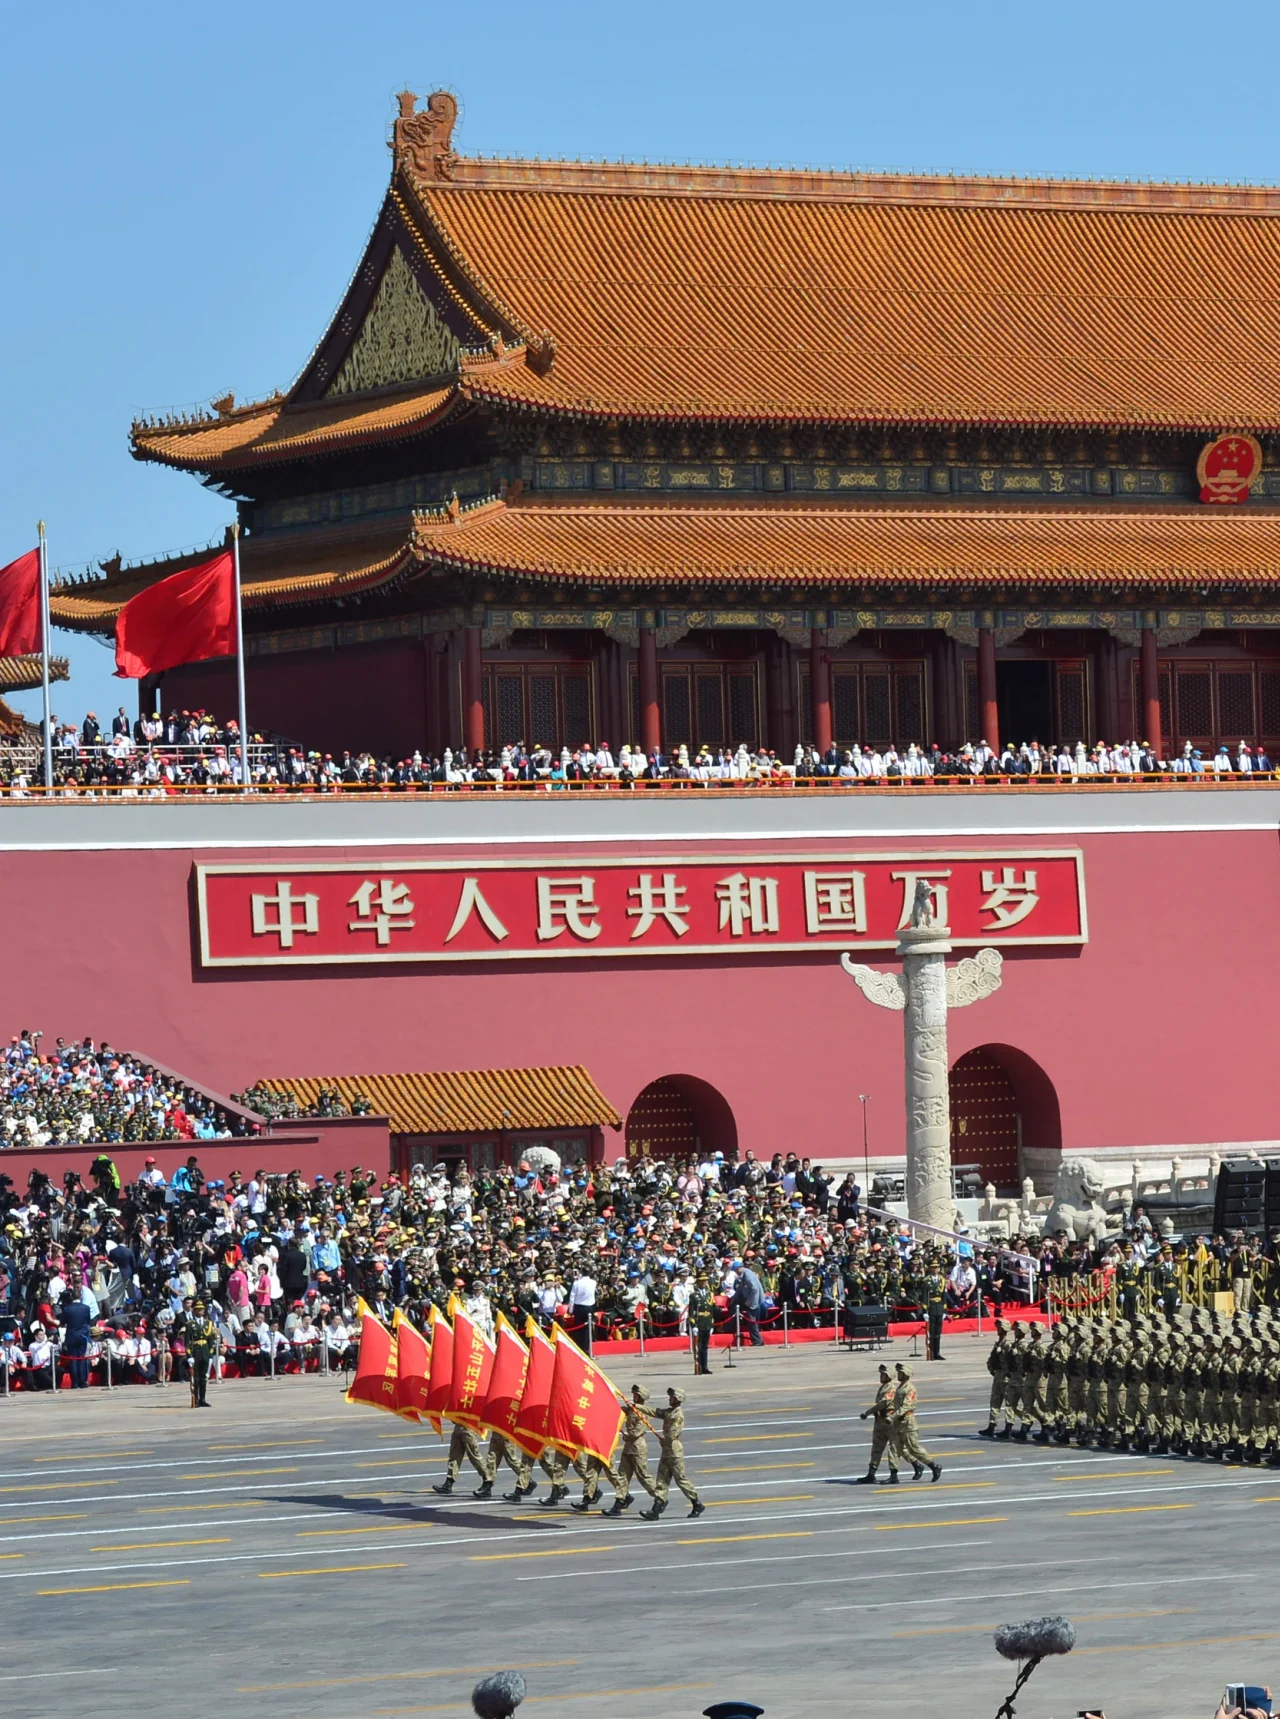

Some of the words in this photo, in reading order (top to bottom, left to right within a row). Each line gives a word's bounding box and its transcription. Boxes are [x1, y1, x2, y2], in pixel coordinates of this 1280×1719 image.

[251, 868, 1040, 947] 中华人民共和国万岁
